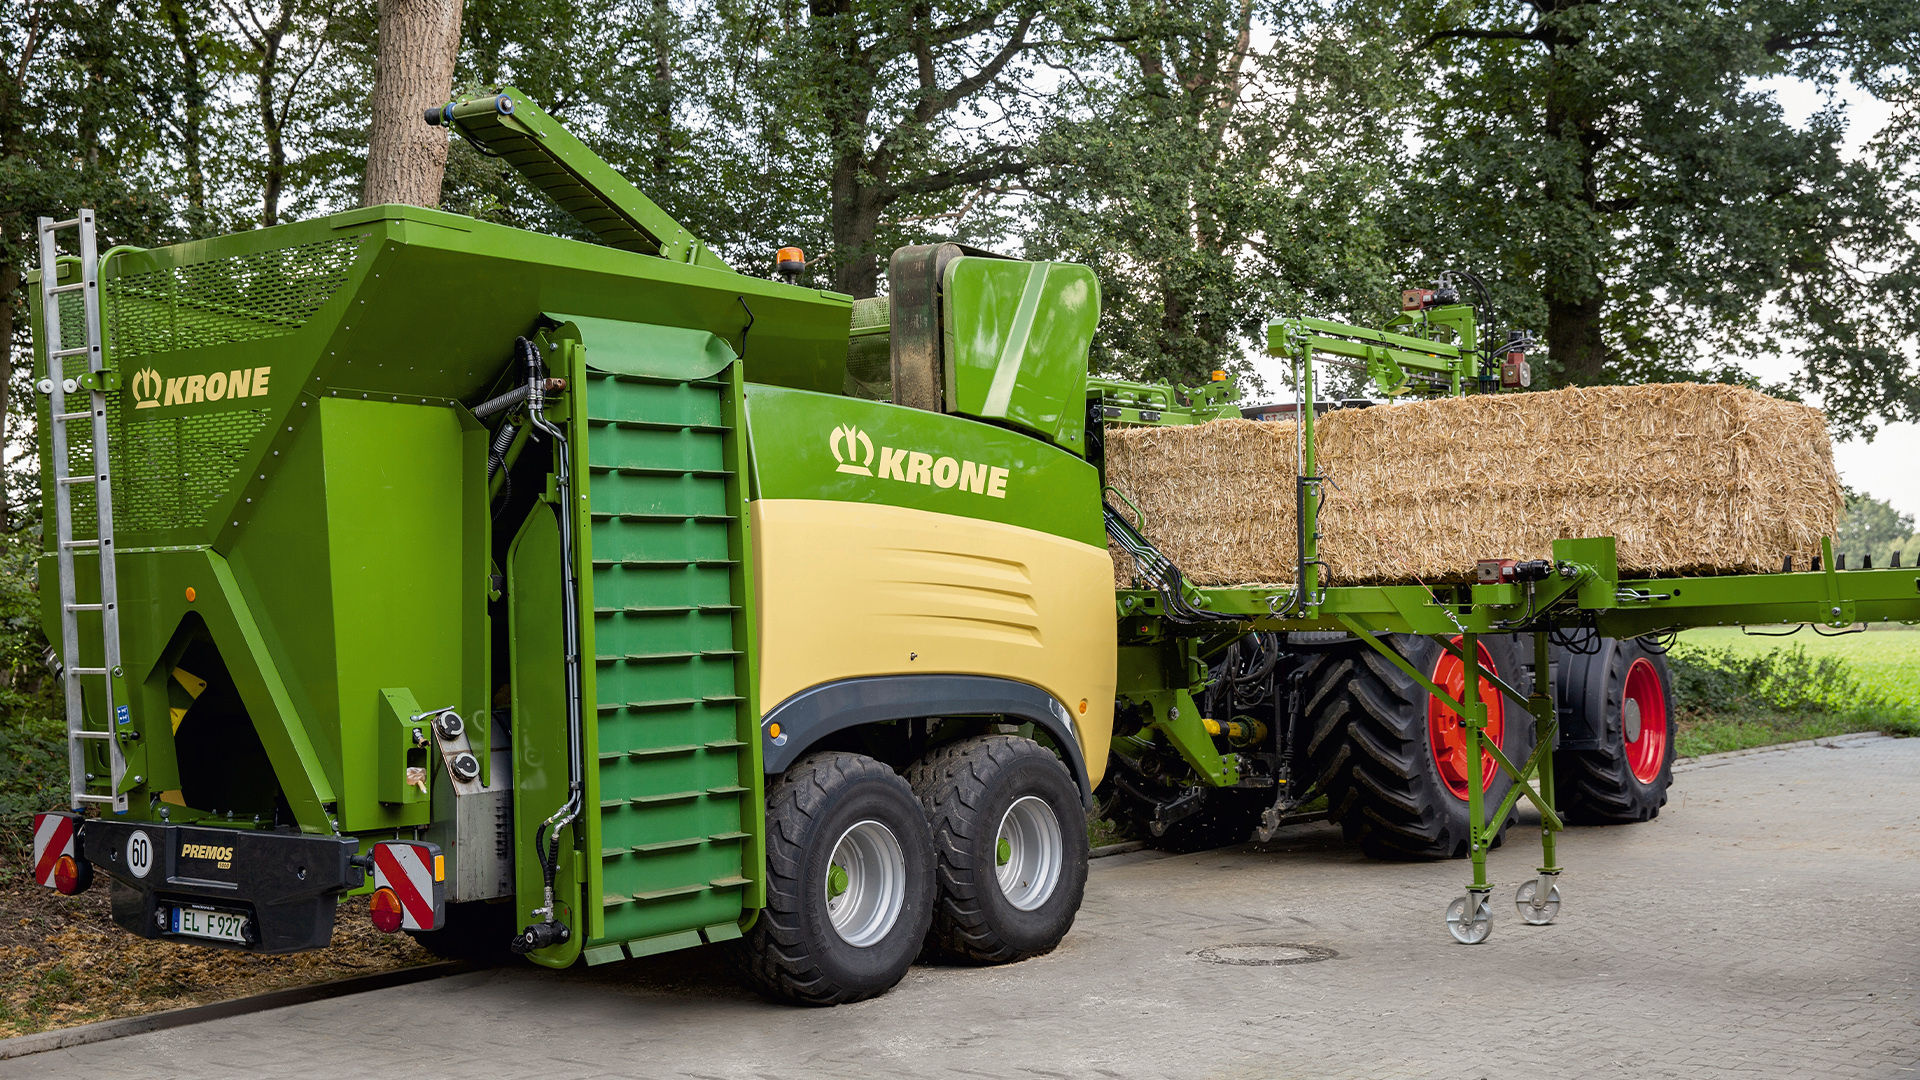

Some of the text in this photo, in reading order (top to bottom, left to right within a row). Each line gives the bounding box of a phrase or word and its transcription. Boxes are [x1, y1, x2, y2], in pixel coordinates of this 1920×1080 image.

[164, 366, 271, 406] KRONE
[878, 446, 1009, 499] KRONE
[133, 838, 147, 868] 60
[181, 843, 233, 861] PREMOS
[183, 911, 199, 932] EL
